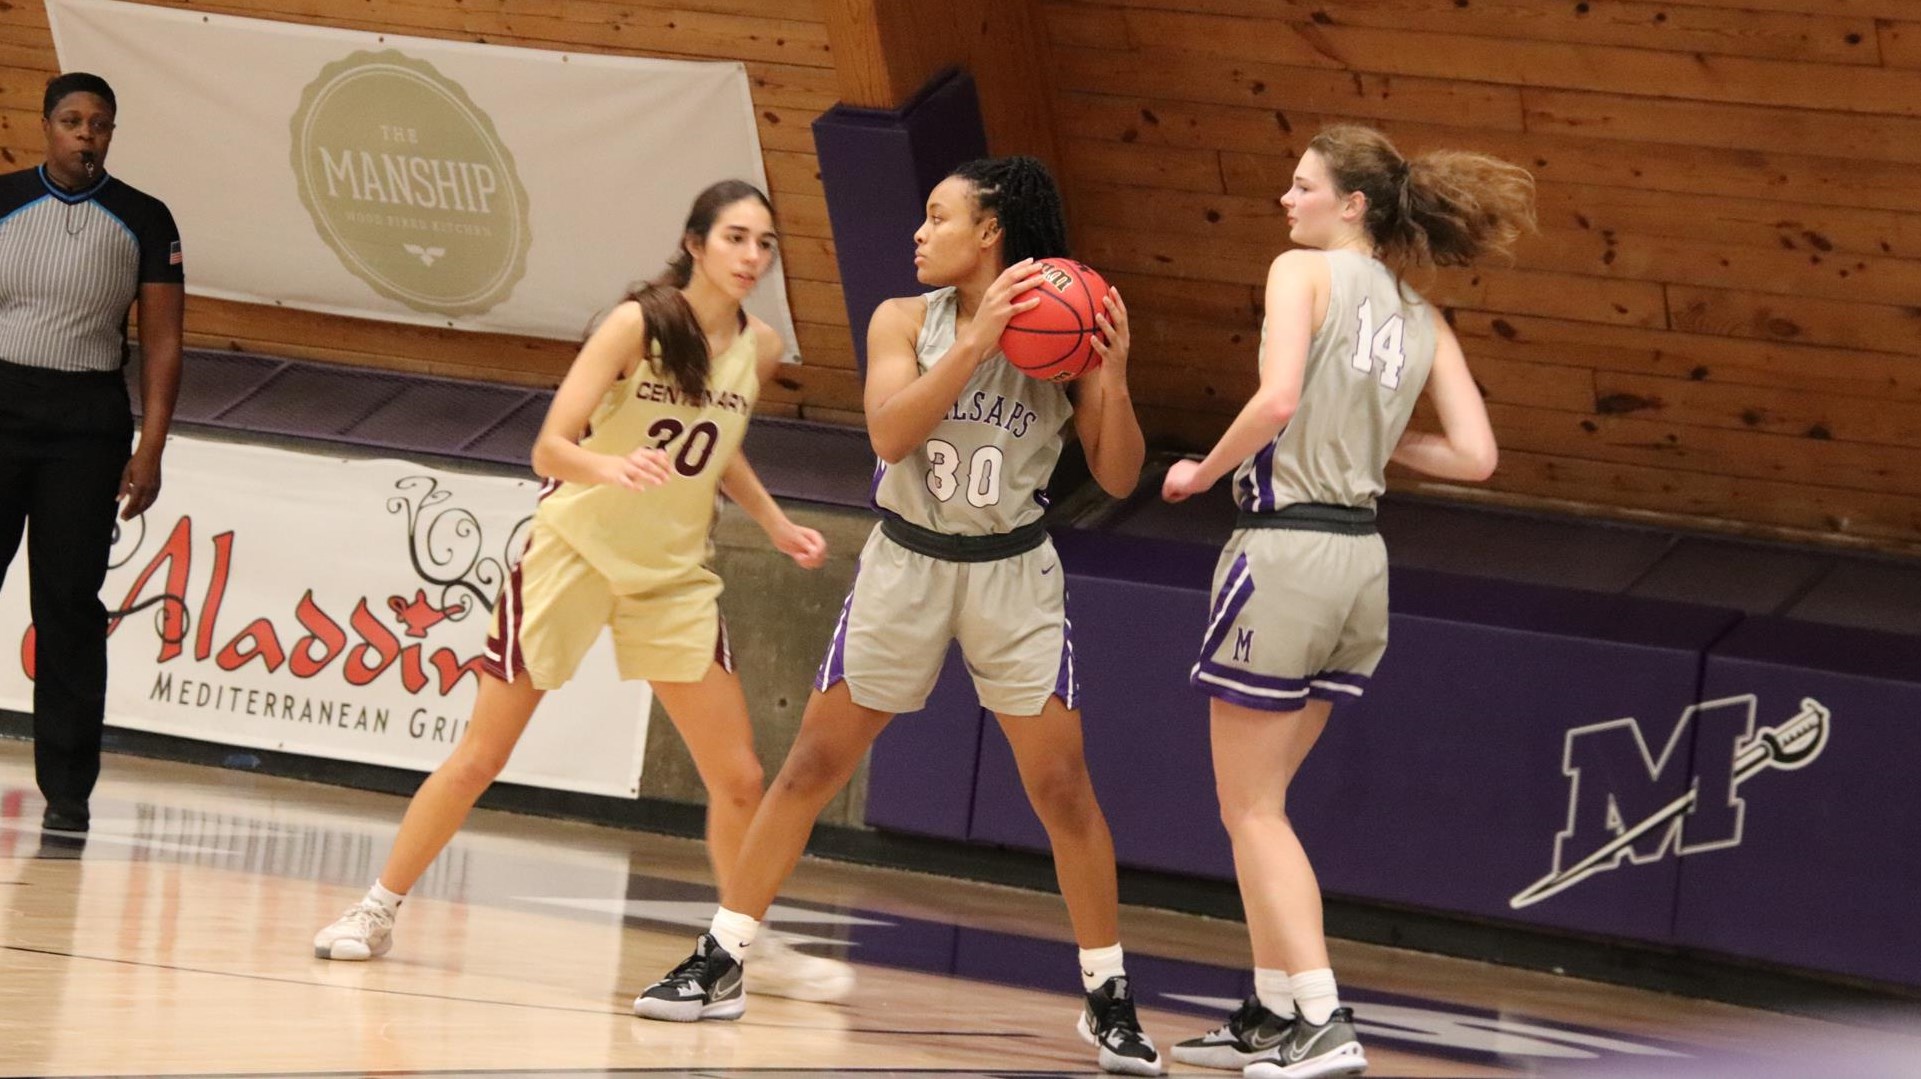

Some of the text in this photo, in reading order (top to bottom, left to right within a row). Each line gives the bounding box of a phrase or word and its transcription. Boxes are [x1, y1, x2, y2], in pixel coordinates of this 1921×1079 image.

[379, 124, 418, 144] THE
[318, 146, 496, 214] MANSHIP
[1351, 297, 1406, 391] 14
[944, 391, 1037, 438] LSAPS
[925, 438, 1004, 508] 30
[1232, 626, 1254, 663] M
[150, 671, 389, 732] MEDITERRANEAN
